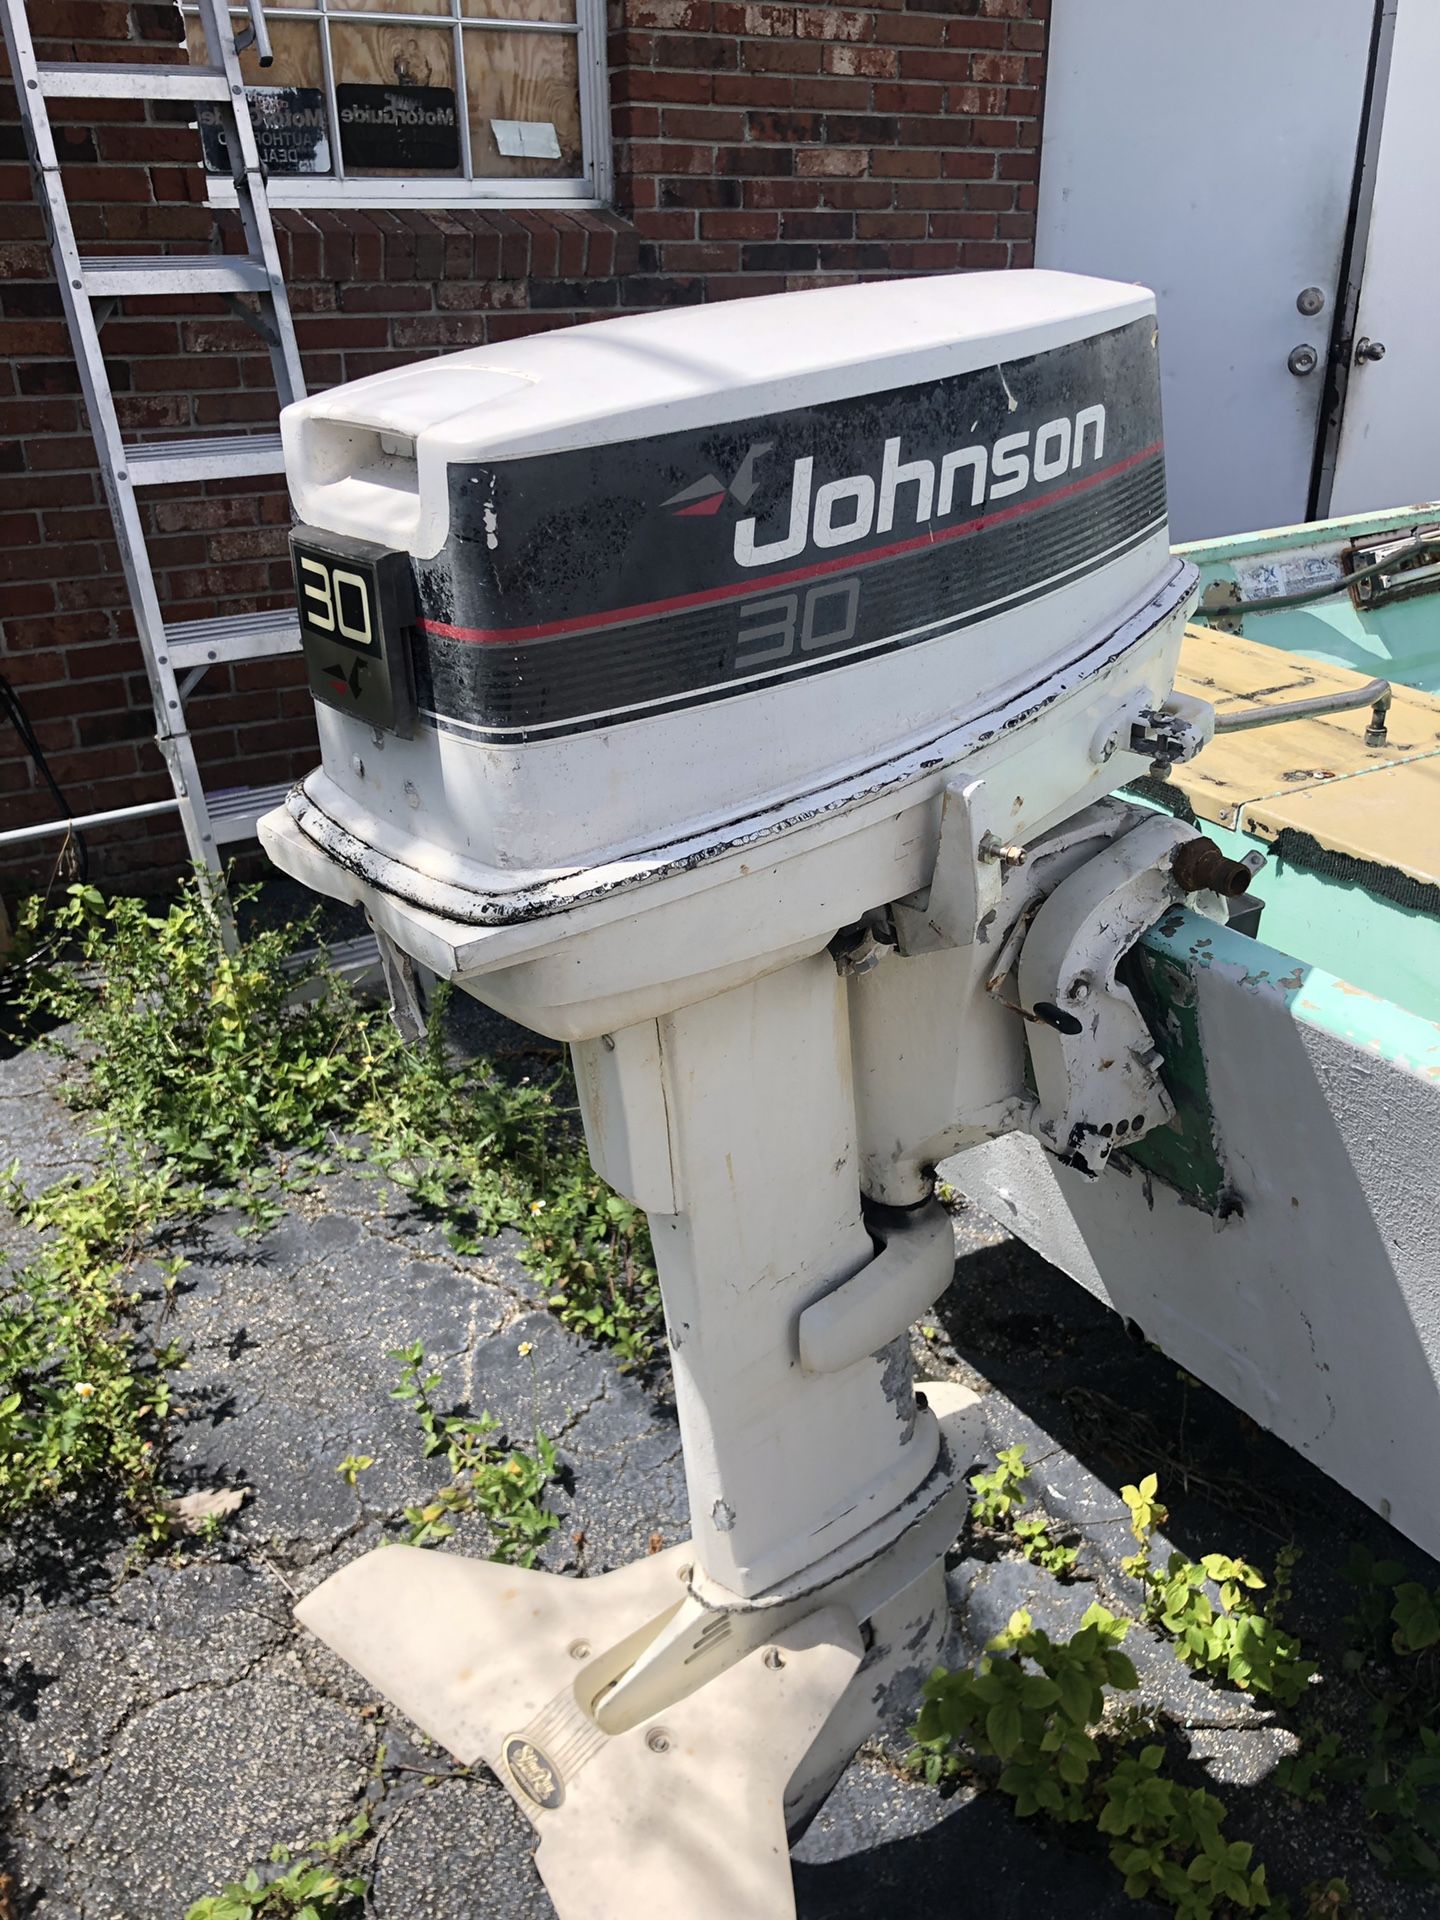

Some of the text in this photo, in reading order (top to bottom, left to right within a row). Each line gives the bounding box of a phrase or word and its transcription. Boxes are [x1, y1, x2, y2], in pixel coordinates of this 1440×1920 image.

[733, 403, 1106, 567] Johnson
[301, 556, 372, 645] 30
[734, 577, 861, 669] 30
